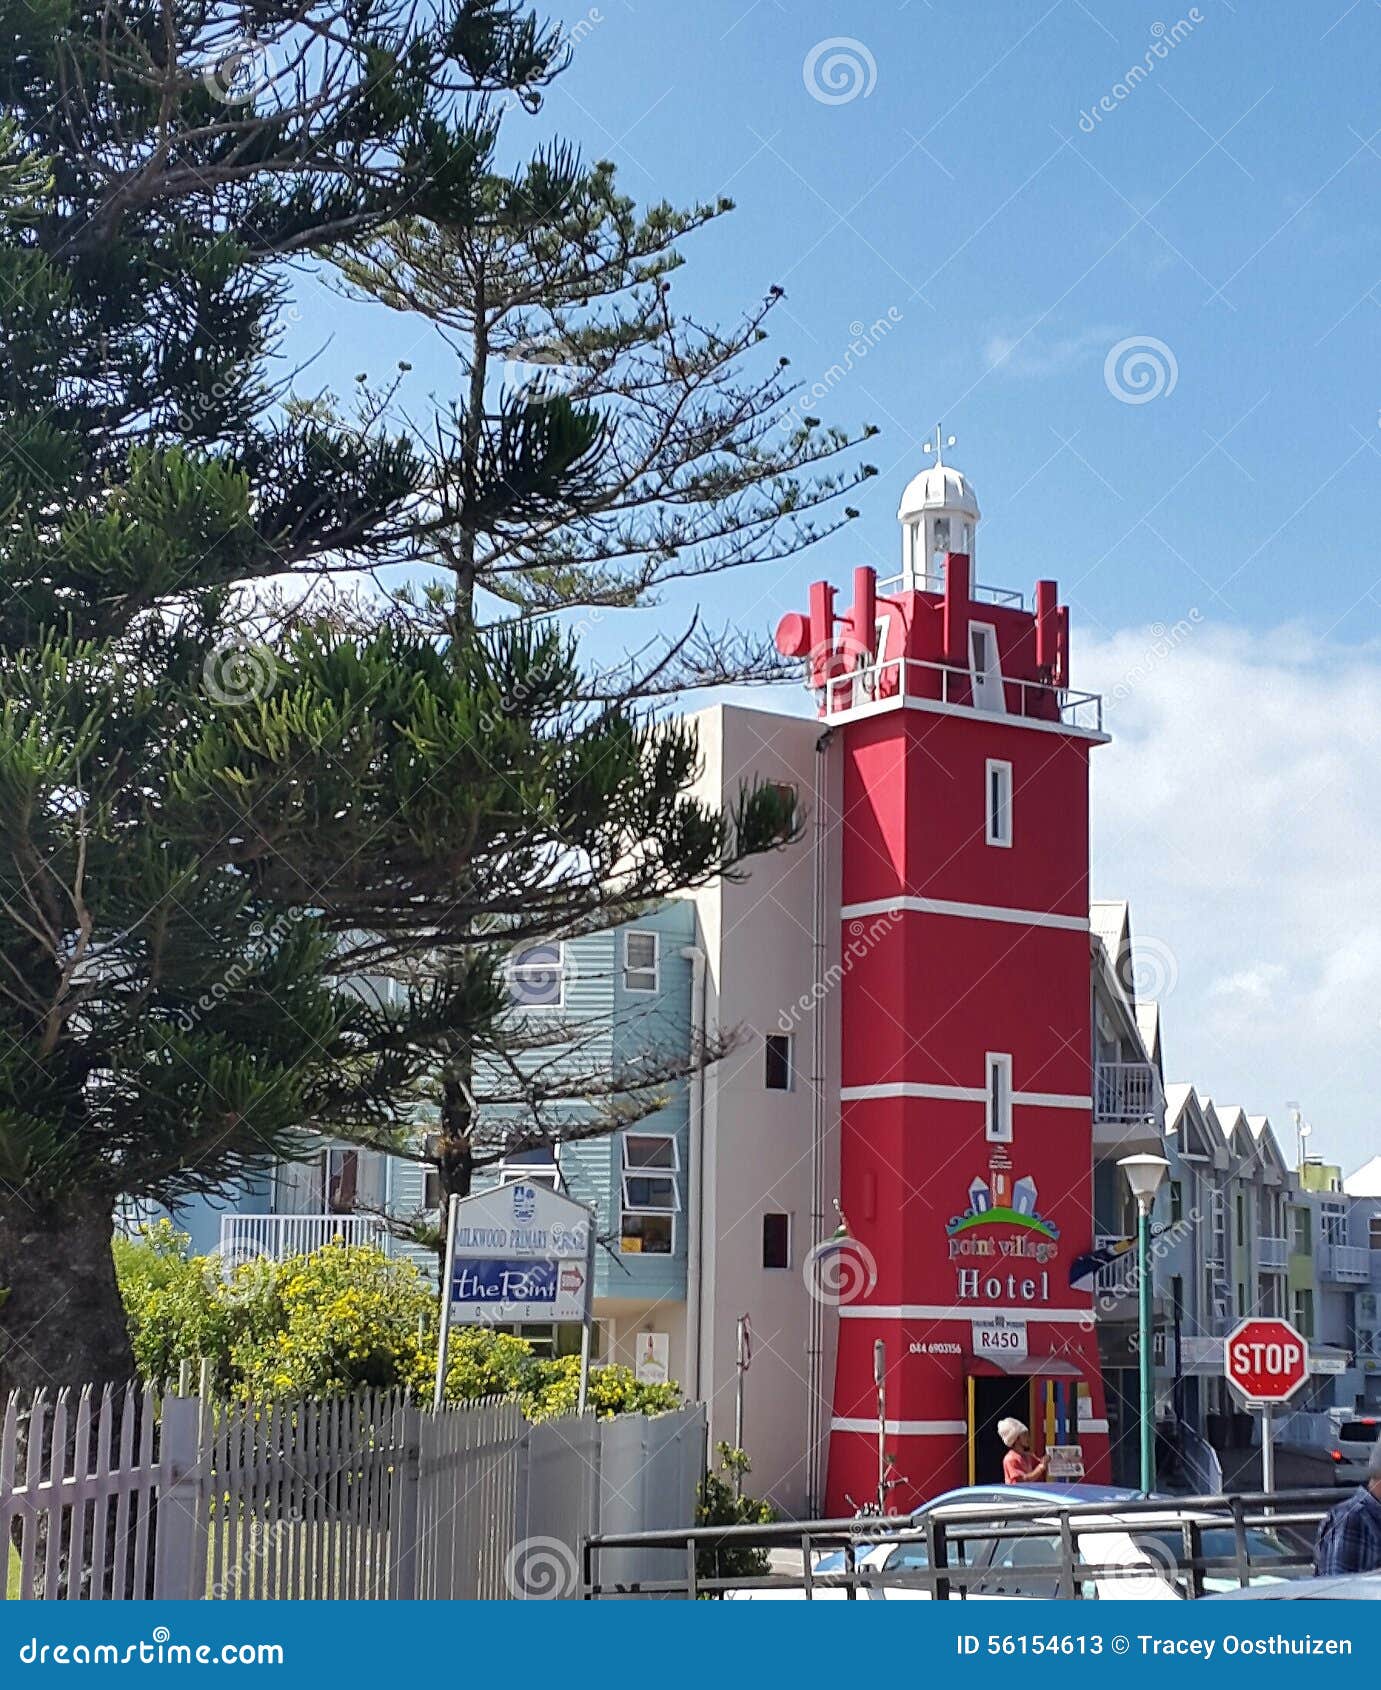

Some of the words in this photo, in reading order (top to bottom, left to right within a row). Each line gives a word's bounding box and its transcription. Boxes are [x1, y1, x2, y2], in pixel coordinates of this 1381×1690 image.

[948, 1233, 995, 1260] point
[998, 1234, 1059, 1264] village
[957, 1267, 1049, 1300] Hotel
[981, 1331, 1019, 1349] R450
[1233, 1342, 1301, 1376] STOP
